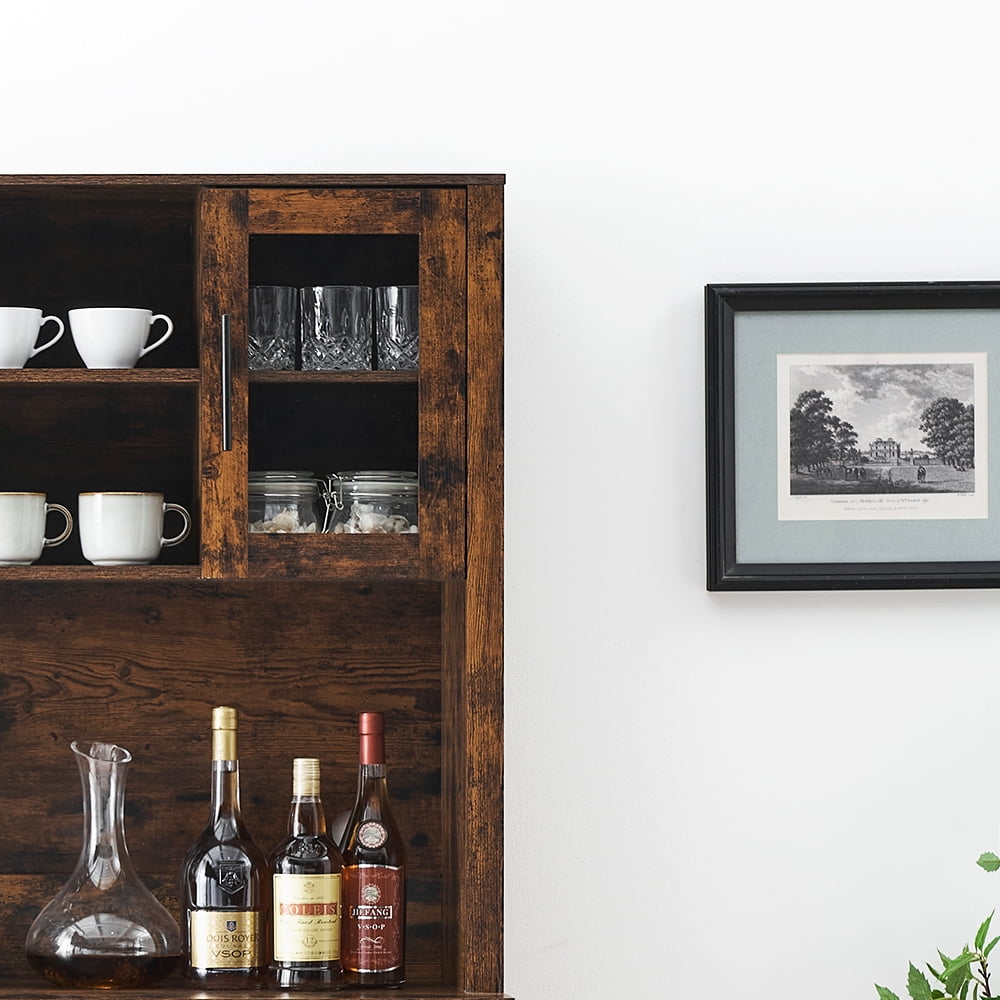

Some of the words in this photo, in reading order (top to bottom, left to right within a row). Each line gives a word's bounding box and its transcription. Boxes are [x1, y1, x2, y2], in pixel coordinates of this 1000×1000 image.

[352, 908, 389, 916] JIEFANG
[205, 934, 229, 943] OUIS
[211, 949, 252, 958] VSOP
